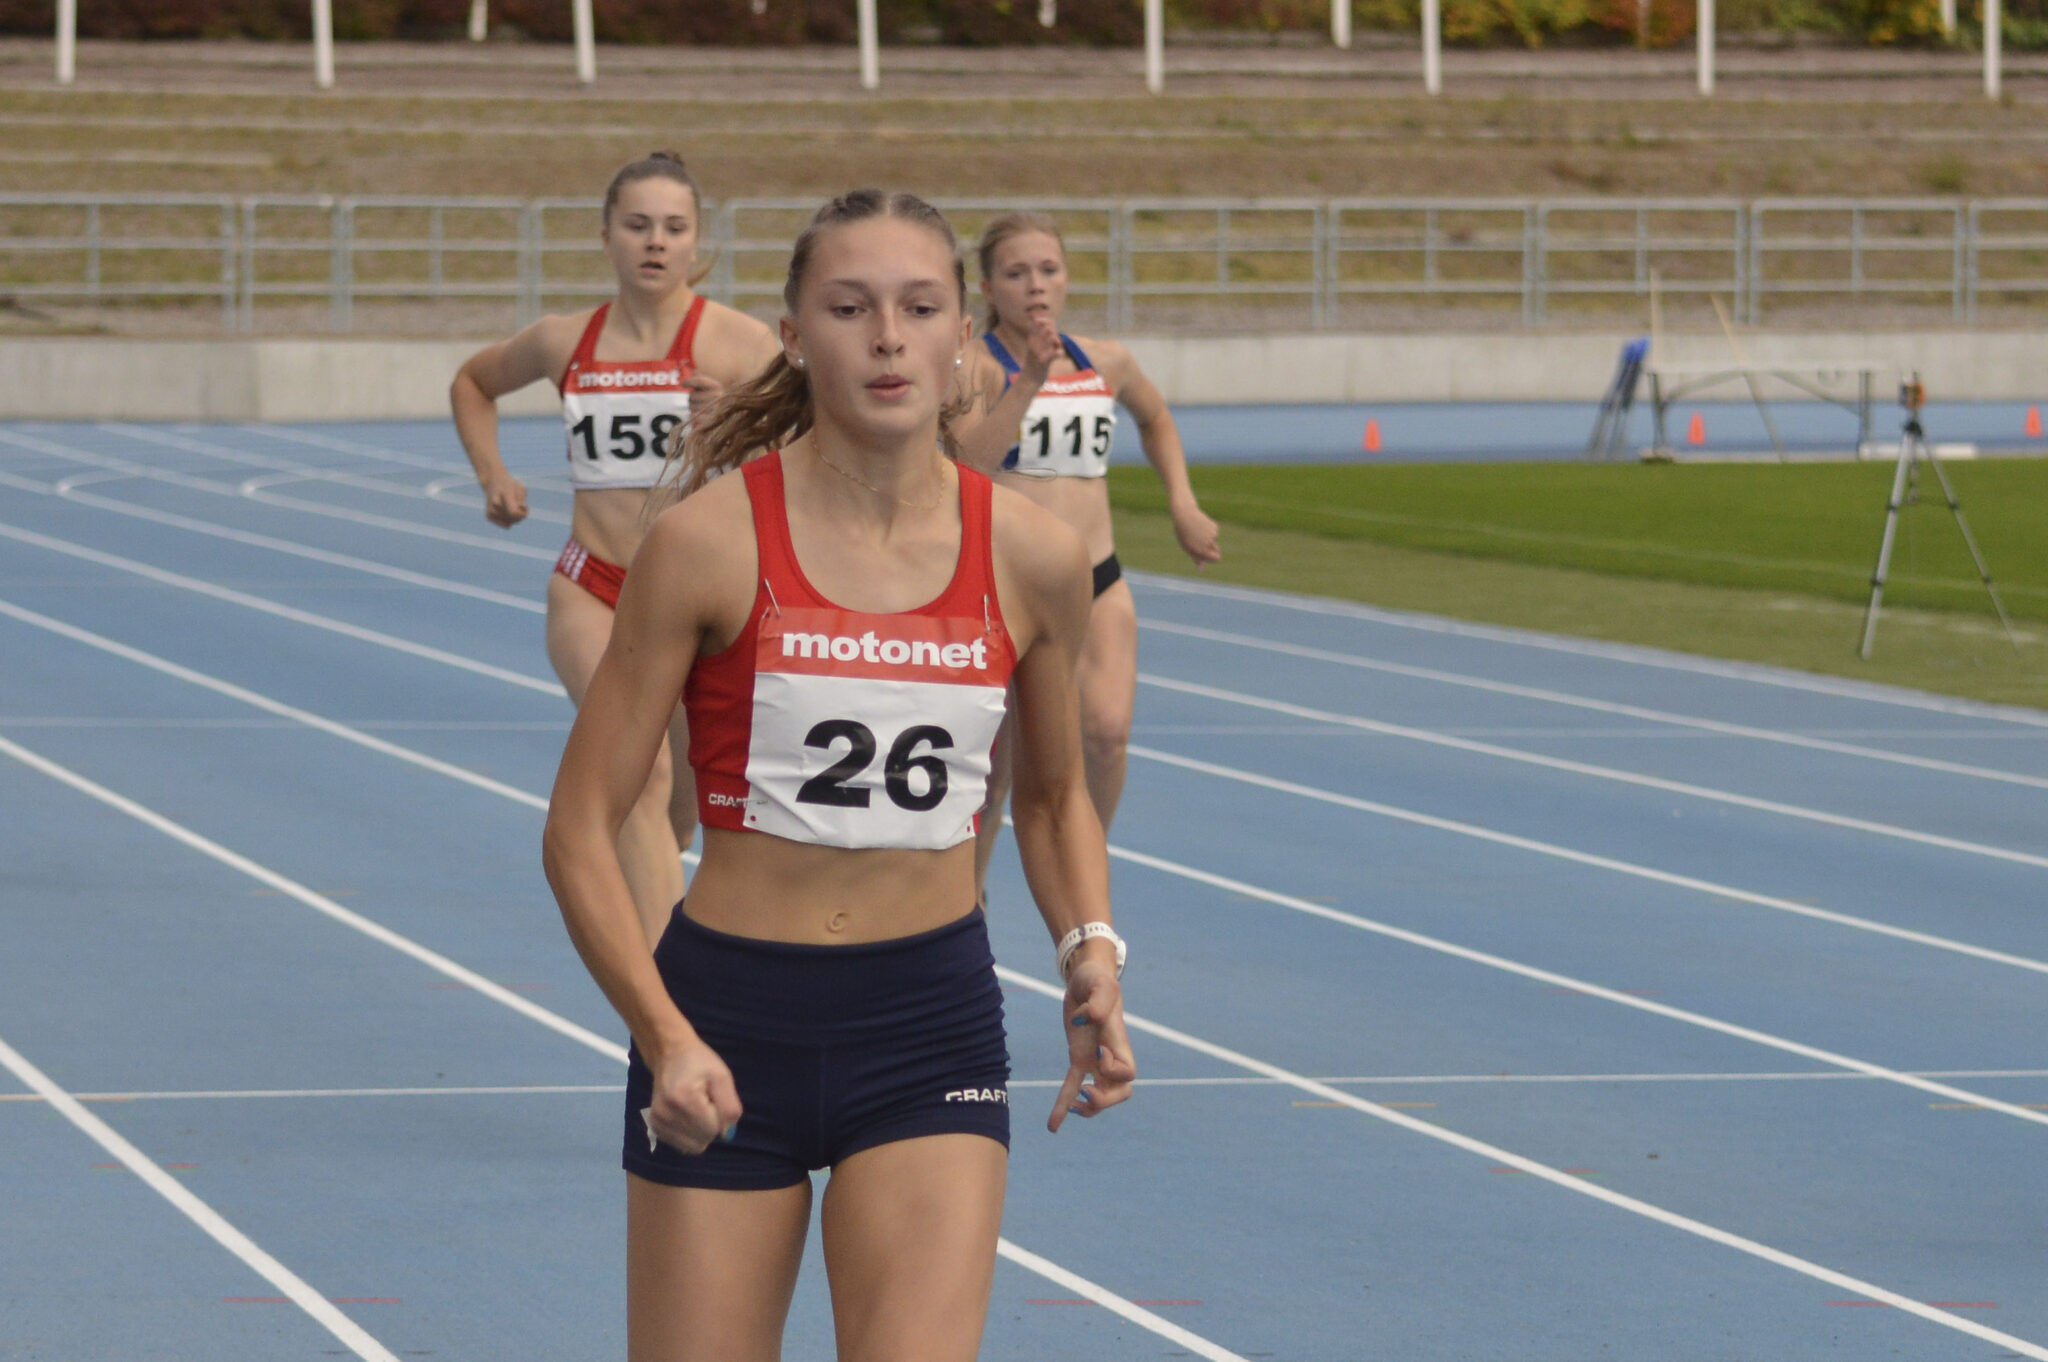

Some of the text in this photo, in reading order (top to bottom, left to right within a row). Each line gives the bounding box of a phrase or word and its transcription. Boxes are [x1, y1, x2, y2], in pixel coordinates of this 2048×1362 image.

[578, 370, 680, 388] motonet
[572, 414, 687, 460] 158
[1029, 416, 1112, 457] 115
[782, 630, 987, 670] motonet
[795, 719, 954, 812] 26
[945, 1088, 1007, 1104] CRAFT
